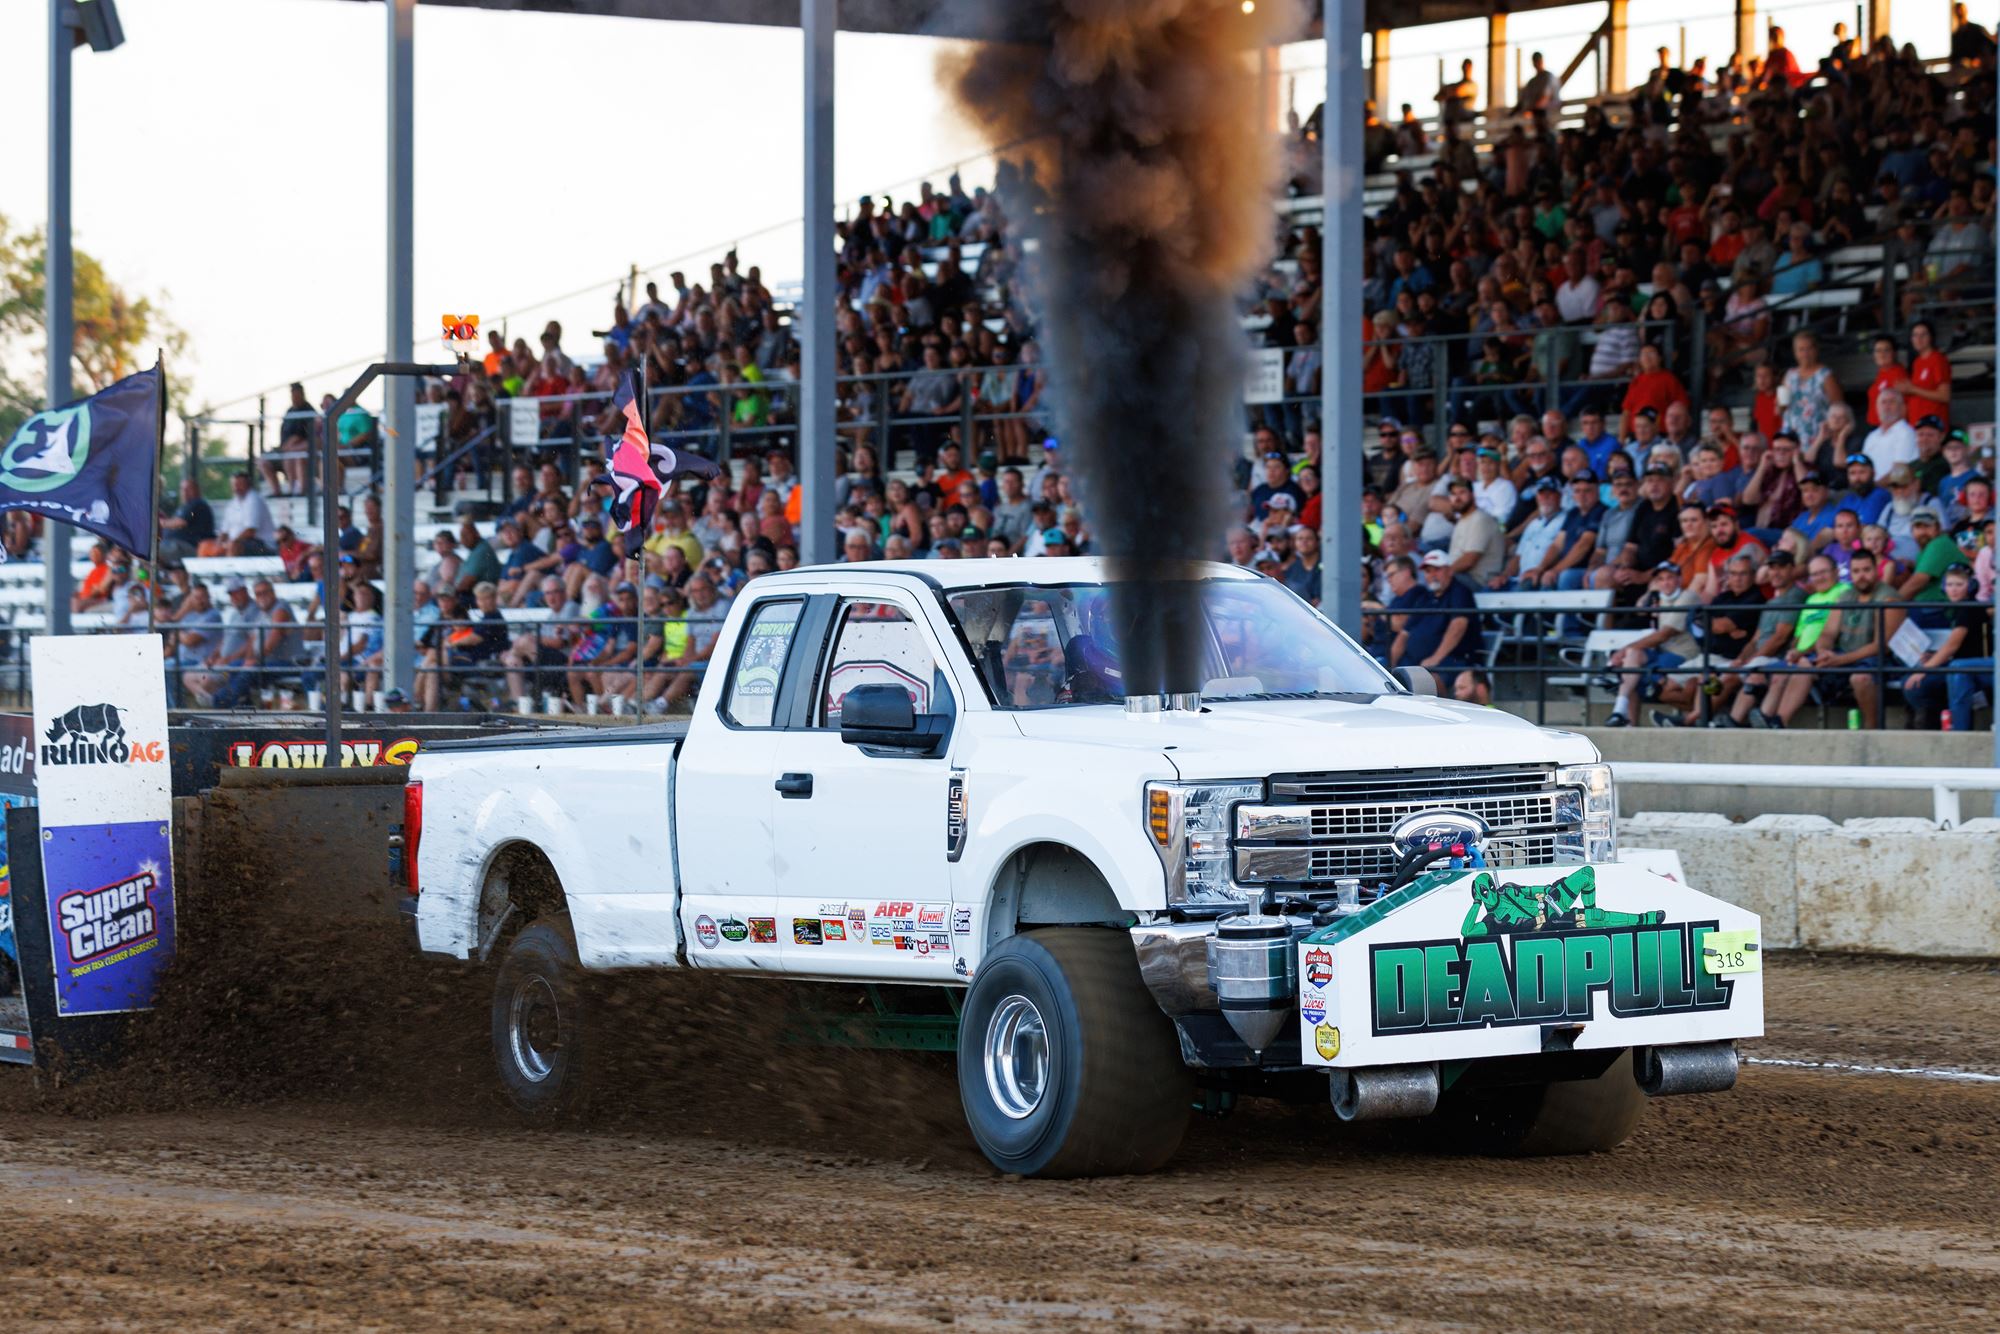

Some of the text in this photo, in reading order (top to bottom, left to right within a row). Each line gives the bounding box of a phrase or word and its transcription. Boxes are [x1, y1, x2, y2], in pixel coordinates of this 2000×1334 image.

[1422, 827, 1462, 845] Ford
[60, 876, 153, 931] Super
[874, 902, 914, 917] ARP
[918, 906, 947, 925] SUMMIT
[70, 908, 153, 959] Clean
[929, 934, 949, 945] OPTIMA
[1307, 954, 1321, 963] LUCAS
[1715, 951, 1745, 969] 318
[1304, 1000, 1325, 1009] LUCAS
